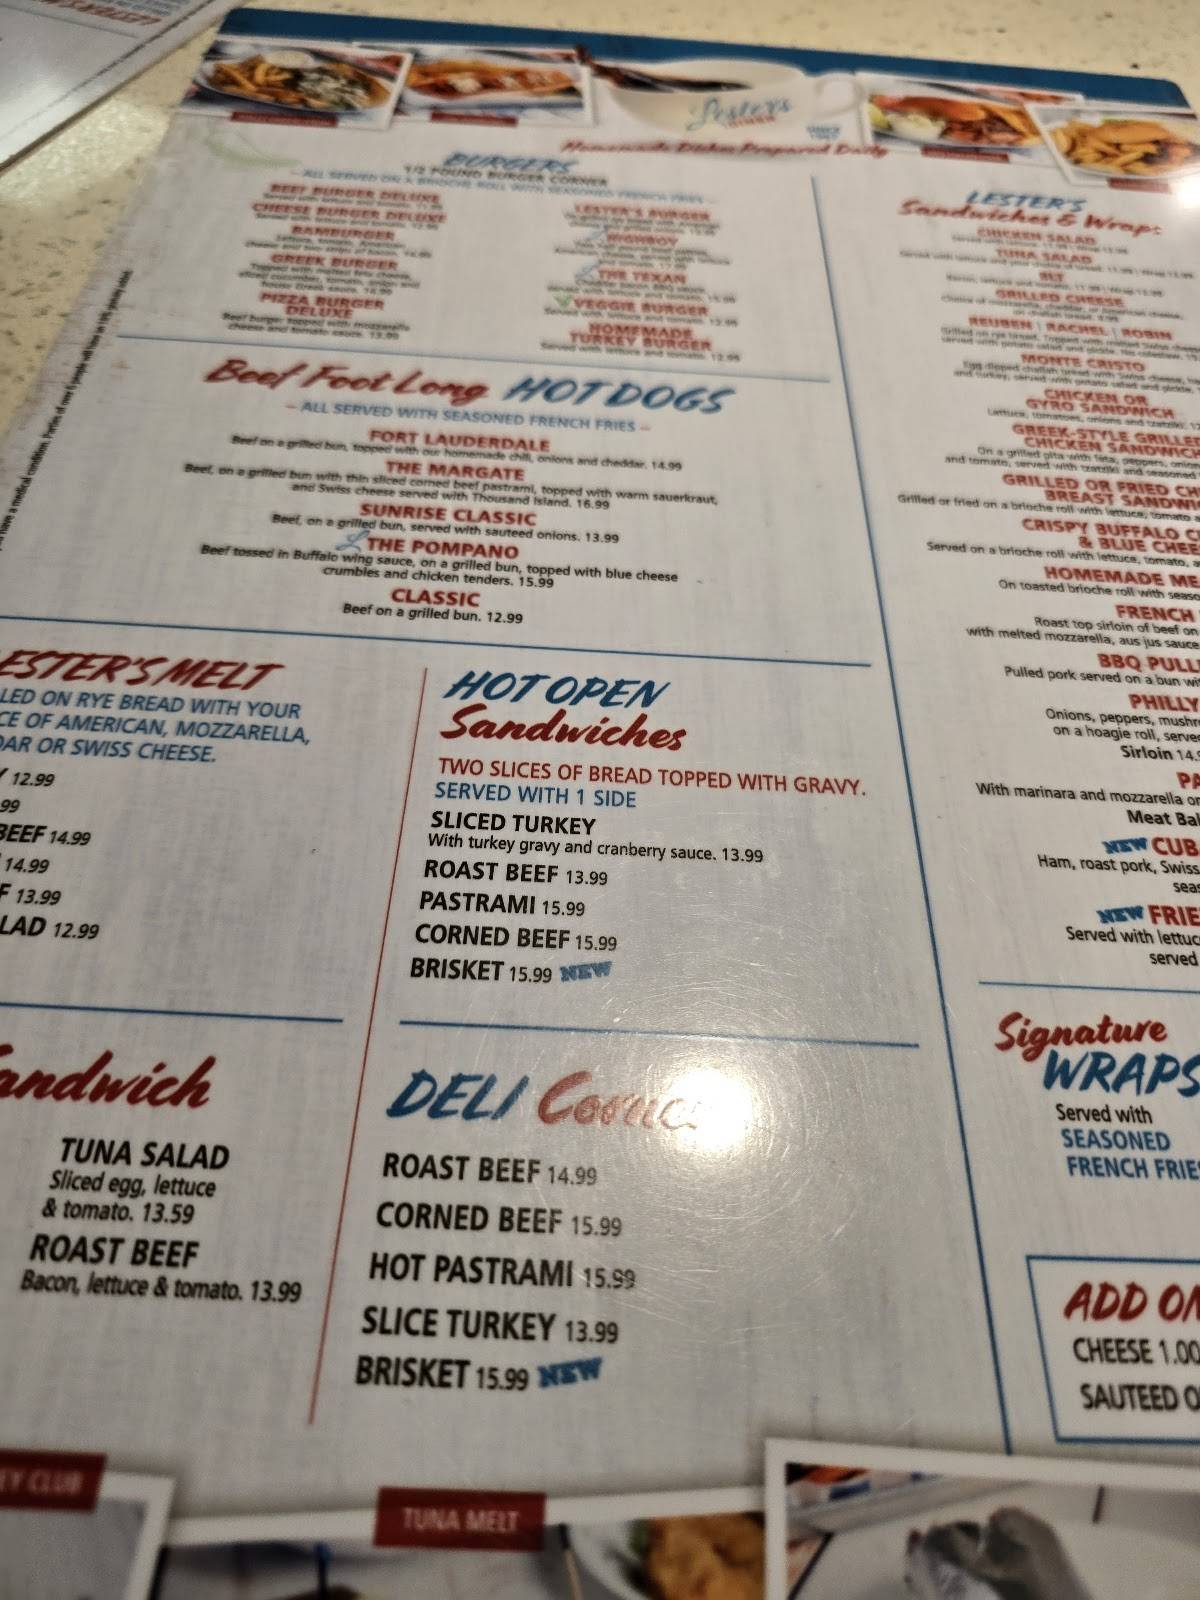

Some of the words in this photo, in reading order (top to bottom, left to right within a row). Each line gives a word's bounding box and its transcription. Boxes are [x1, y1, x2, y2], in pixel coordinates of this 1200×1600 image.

[898, 200, 1051, 226] Sandwiches
[1057, 214, 1077, 226] &
[204, 358, 309, 390] Beef
[300, 365, 391, 391] Foot
[393, 370, 488, 407] Long
[502, 375, 613, 406] HOT
[604, 382, 735, 415] DOGS
[300, 401, 327, 414] ALL
[333, 403, 392, 417] SERVED
[398, 406, 437, 420] WITH
[443, 410, 524, 426] SEASONED
[529, 413, 590, 429] FRENCH
[595, 419, 636, 432] FRIES
[369, 430, 418, 445] FORT
[425, 430, 550, 452] LAUDERDALE
[386, 460, 421, 475] THE
[428, 462, 525, 481] MARGATE
[1002, 473, 1079, 490] GRILLED
[1085, 479, 1110, 493] OR
[1116, 481, 1169, 497] FRIED
[359, 502, 447, 521] SUNRISE
[454, 508, 537, 526] CLASSIC
[367, 537, 405, 553] THE
[411, 539, 519, 559] POMPANO
[323, 565, 379, 579] crumbles
[384, 568, 408, 581] and
[413, 570, 459, 584] chicken
[464, 574, 513, 587] tenders.
[519, 577, 554, 588] 15.99
[1044, 566, 1164, 586] HOMEMADE
[391, 588, 480, 608] CLASSIC
[1115, 604, 1194, 622] FRENCH
[152, 657, 287, 691] MELT
[1097, 652, 1141, 670] BBQ
[442, 670, 554, 704] HOT
[545, 675, 671, 708] OPEN
[1004, 666, 1043, 680] Pulled
[1047, 668, 1076, 682] pork
[1080, 670, 1121, 684] served
[1125, 674, 1141, 684] on
[1146, 676, 1152, 685] a
[1156, 674, 1180, 687] bun
[41, 689, 70, 707] ON
[76, 691, 113, 709] RYE
[119, 694, 184, 713] BREAD
[191, 698, 241, 716] WITH
[247, 701, 302, 720] YOUR
[1128, 694, 1199, 713] PHILLY
[24, 712, 53, 729] OF
[55, 715, 169, 738] AMERICAN,
[175, 720, 311, 746] MOZZARELLA,
[439, 702, 688, 751] Sandwiches
[36, 737, 65, 755] OR
[70, 738, 131, 759] SWISS
[137, 742, 217, 763] CHEESE.
[1120, 745, 1173, 761] Sirloin
[12, 771, 55, 787] 12.99
[439, 757, 484, 776] TWO
[490, 760, 551, 780] SLICES
[558, 763, 583, 781] OF
[589, 765, 652, 785] BREAD
[658, 768, 733, 790] TOPPED
[738, 772, 787, 792] WITH
[793, 776, 866, 797] GRAVY.
[434, 781, 512, 802] SERVED
[518, 785, 568, 804] WITH
[577, 789, 585, 806] 1
[593, 789, 637, 808] SIDE
[975, 782, 1010, 796] With
[1014, 787, 1076, 800] marinara
[1080, 788, 1105, 801] and
[1110, 791, 1183, 806] mozzarella
[430, 810, 506, 832] SLICED
[512, 814, 596, 836] TURKEY
[1127, 810, 1172, 826] Meat
[49, 830, 92, 846] 14.99
[428, 832, 463, 849] With
[468, 835, 515, 854] turkey
[519, 840, 560, 856] gravy
[565, 840, 592, 855] and
[597, 842, 666, 862] cranberry
[670, 848, 717, 861] sauce.
[721, 848, 764, 863] 13.99
[1102, 836, 1148, 855] NEW
[4, 857, 50, 874] 14.99
[423, 858, 499, 881] ROAST
[505, 862, 559, 884] BEEF
[566, 869, 608, 886] 13.99
[15, 889, 62, 906] 13.99
[418, 890, 535, 915] PASTRAMI
[542, 900, 585, 917] 15.99
[1096, 905, 1144, 924] NEW
[53, 922, 100, 940] 12.99
[415, 922, 510, 947] CORNED
[517, 928, 571, 950] BEEF
[575, 935, 618, 952] 15.99
[410, 956, 504, 982] BRISKET
[509, 966, 552, 984] 15.99
[560, 960, 613, 982] NEW
[994, 1011, 1168, 1063] Signature
[0, 1044, 216, 1108] andwich
[385, 1068, 530, 1121] DELI
[1055, 1103, 1111, 1123] Served
[1115, 1104, 1153, 1125] with
[1061, 1128, 1171, 1151] SEASONED
[60, 1137, 133, 1167] TUNA
[140, 1141, 231, 1171] SALAD
[1066, 1155, 1149, 1180] FRENCH
[383, 1152, 471, 1179] ROAST
[477, 1157, 541, 1184] BEEF
[547, 1166, 598, 1186] 14.99
[49, 1169, 106, 1193] Sliced
[108, 1175, 146, 1198] egg,
[153, 1174, 216, 1198] lettuce
[42, 1197, 57, 1219] &
[63, 1199, 133, 1222] tomato.
[142, 1202, 196, 1225] 13.59
[376, 1201, 489, 1232] CORNED
[498, 1206, 563, 1235] BEEF
[571, 1215, 623, 1238] 15.99
[28, 1233, 125, 1265] ROAST
[130, 1239, 200, 1270] BEEF
[369, 1252, 427, 1282] HOT
[434, 1255, 574, 1289] PASTRAMI
[582, 1266, 637, 1291] 15.99
[20, 1268, 80, 1297] Bacon,
[87, 1270, 149, 1297] lettuce
[153, 1276, 169, 1298] &
[174, 1278, 243, 1302] tomato.
[250, 1279, 303, 1304] 13.99
[1063, 1280, 1149, 1323] ADD
[361, 1304, 439, 1338] SLICE
[447, 1309, 558, 1343] TURKEY
[565, 1320, 619, 1344] 13.99
[1072, 1336, 1154, 1365] CHEESE
[1158, 1339, 1200, 1366] 1.00
[355, 1354, 472, 1389] BRISKET
[476, 1366, 530, 1391] 15.99
[537, 1356, 604, 1389] NEW
[1080, 1382, 1180, 1412] SAUTEED
[403, 1507, 461, 1531] TUNA
[465, 1509, 520, 1533] MELT
